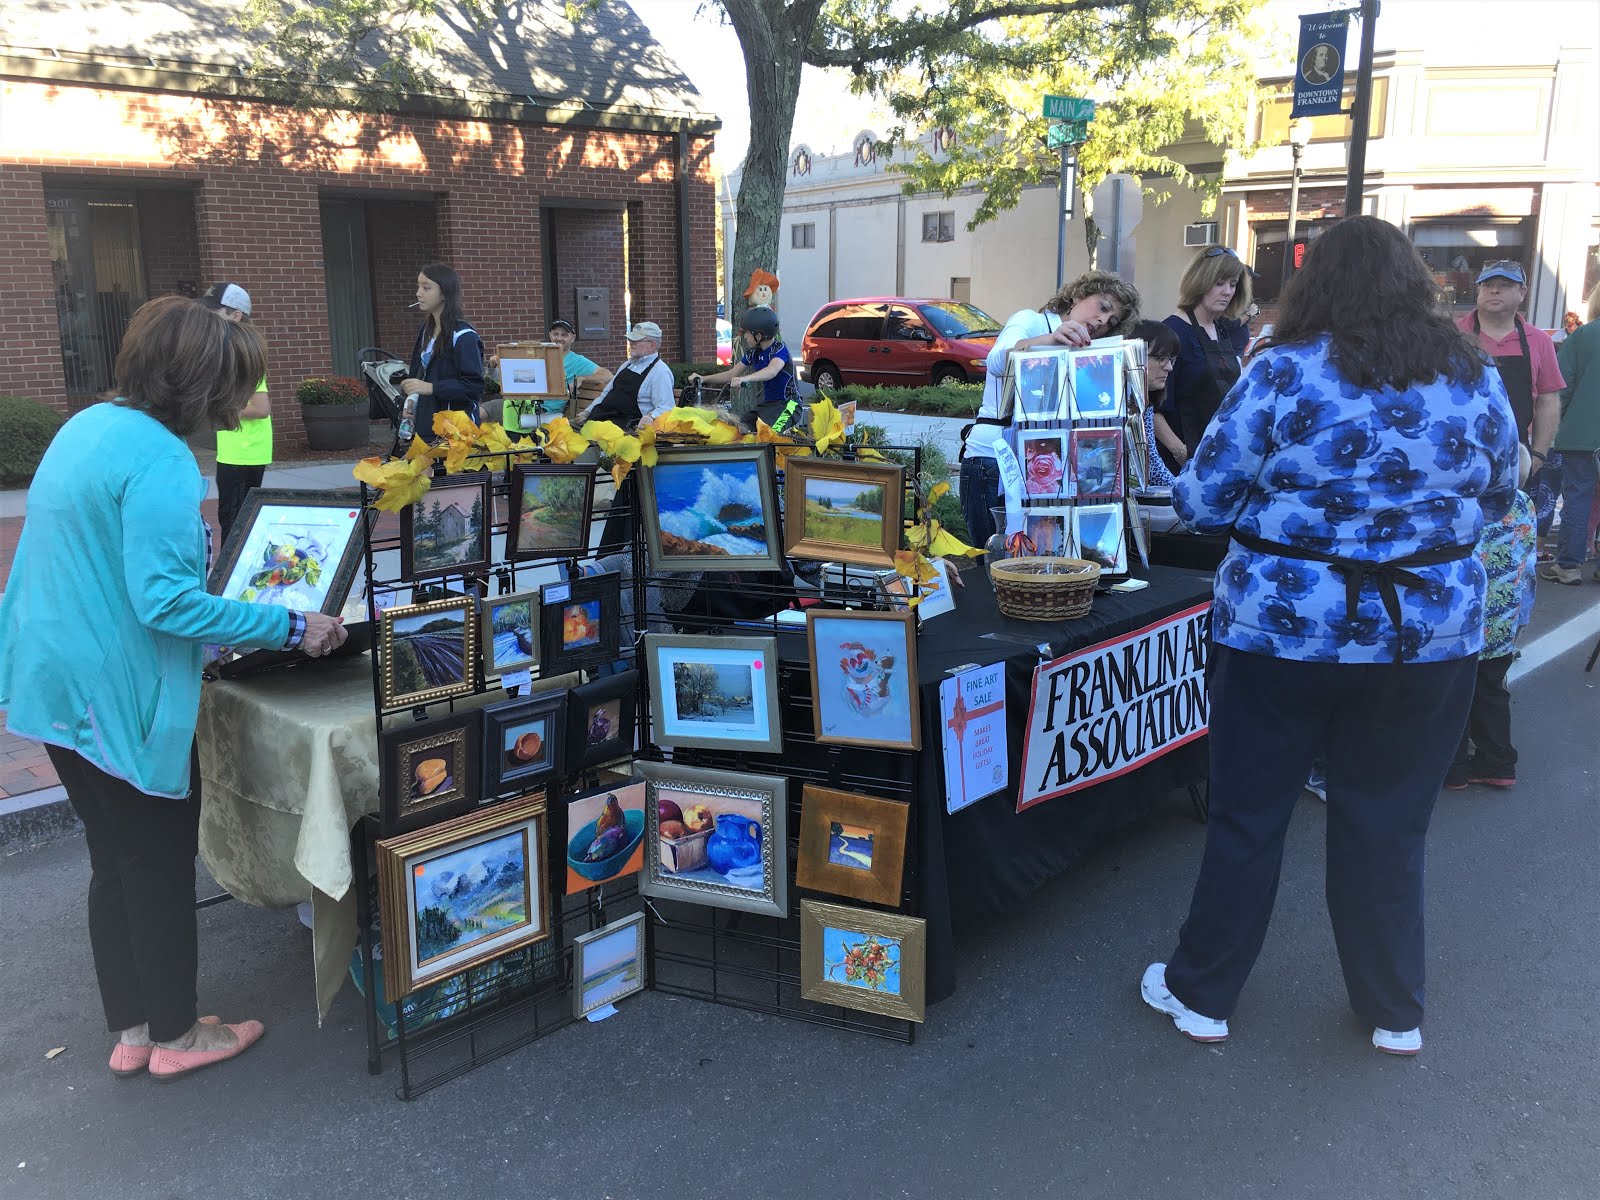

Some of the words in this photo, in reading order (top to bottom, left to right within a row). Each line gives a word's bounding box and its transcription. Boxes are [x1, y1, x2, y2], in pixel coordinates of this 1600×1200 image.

[1304, 21, 1344, 31] Welcome
[1297, 95, 1338, 106] FRANKLIN
[1298, 89, 1339, 99] DOWNTOWN
[1050, 98, 1075, 118] MAIN
[1042, 625, 1180, 733] FRANKLIN
[1181, 614, 1211, 677] AR
[966, 677, 983, 692] FINE
[984, 672, 998, 686] ART
[974, 692, 992, 706] SALE
[974, 724, 991, 736] MAKES
[1039, 675, 1209, 792] ASSOCIATION
[975, 736, 990, 747] GREAT
[972, 747, 993, 760] HOLIDAY
